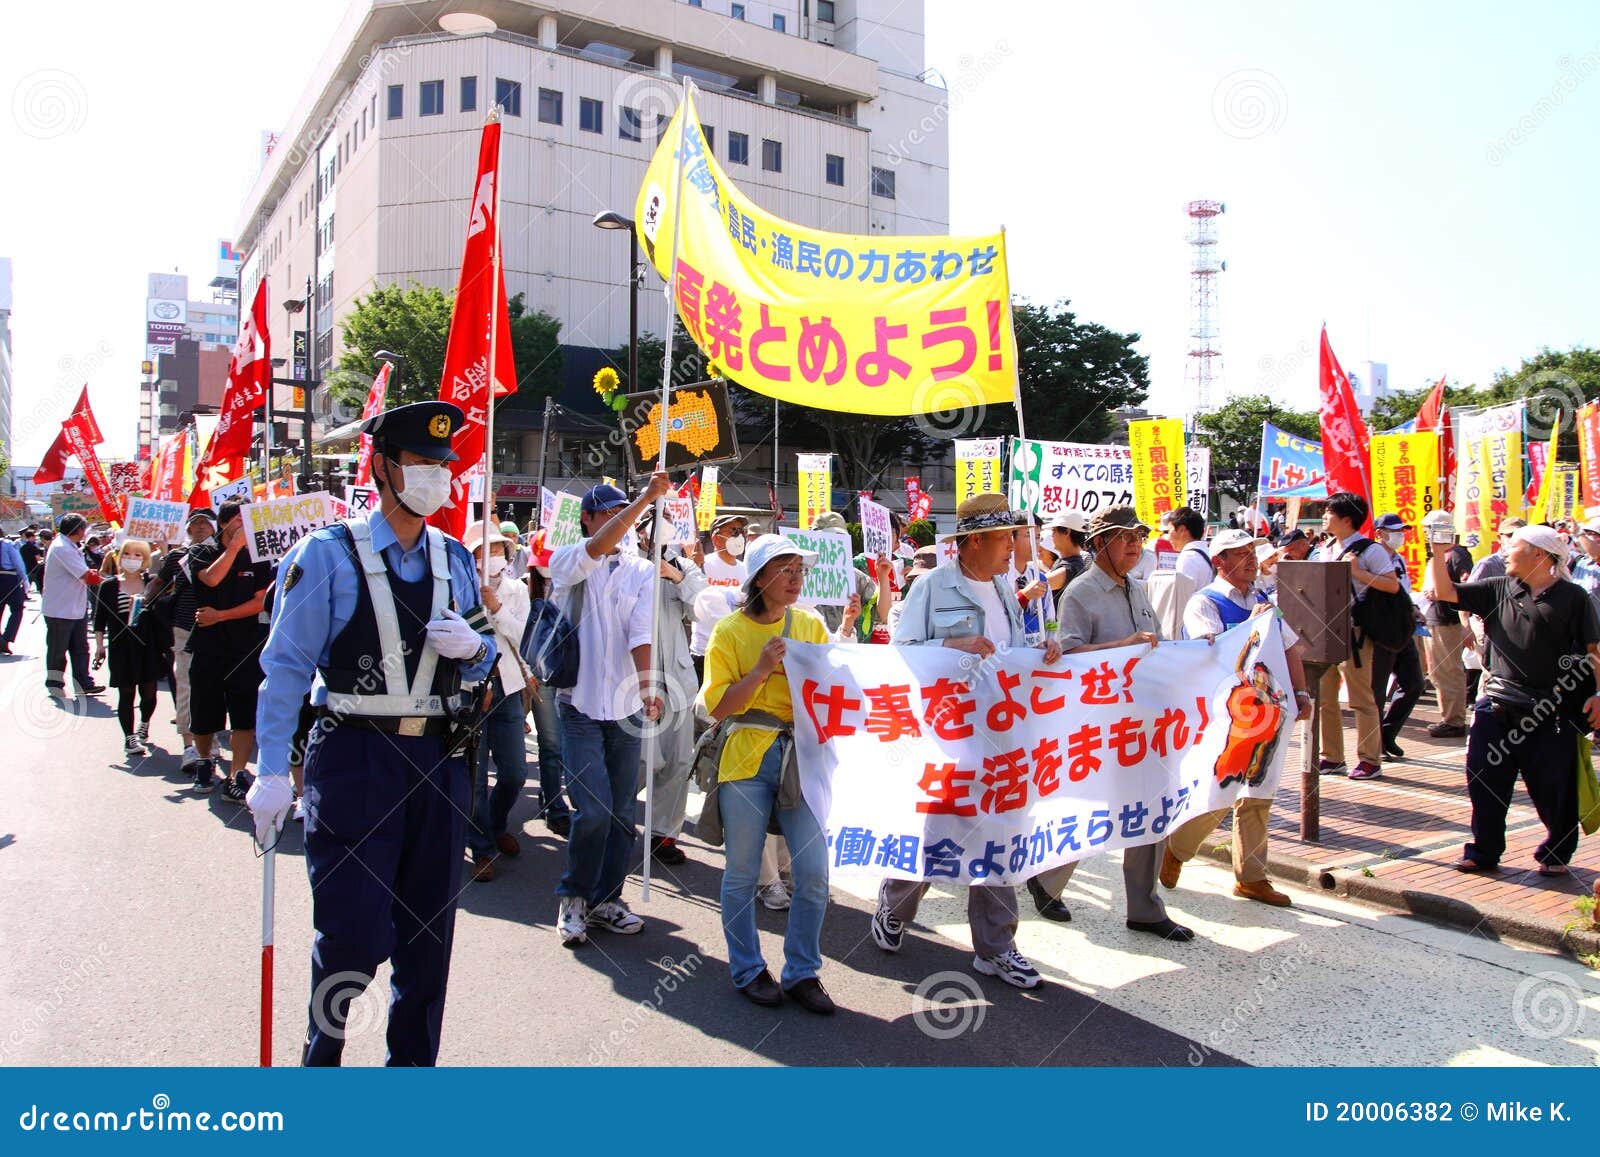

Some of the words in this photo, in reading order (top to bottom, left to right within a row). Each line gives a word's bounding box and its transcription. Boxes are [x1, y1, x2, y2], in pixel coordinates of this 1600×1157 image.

[150, 323, 183, 331] TOYOTA
[676, 258, 1004, 388] 原発とめよう!
[801, 656, 1141, 745] 仕事をよこせ!
[915, 696, 1210, 817] 生活をまもれ!
[827, 779, 1199, 880] 働組合よみがえらせよう
